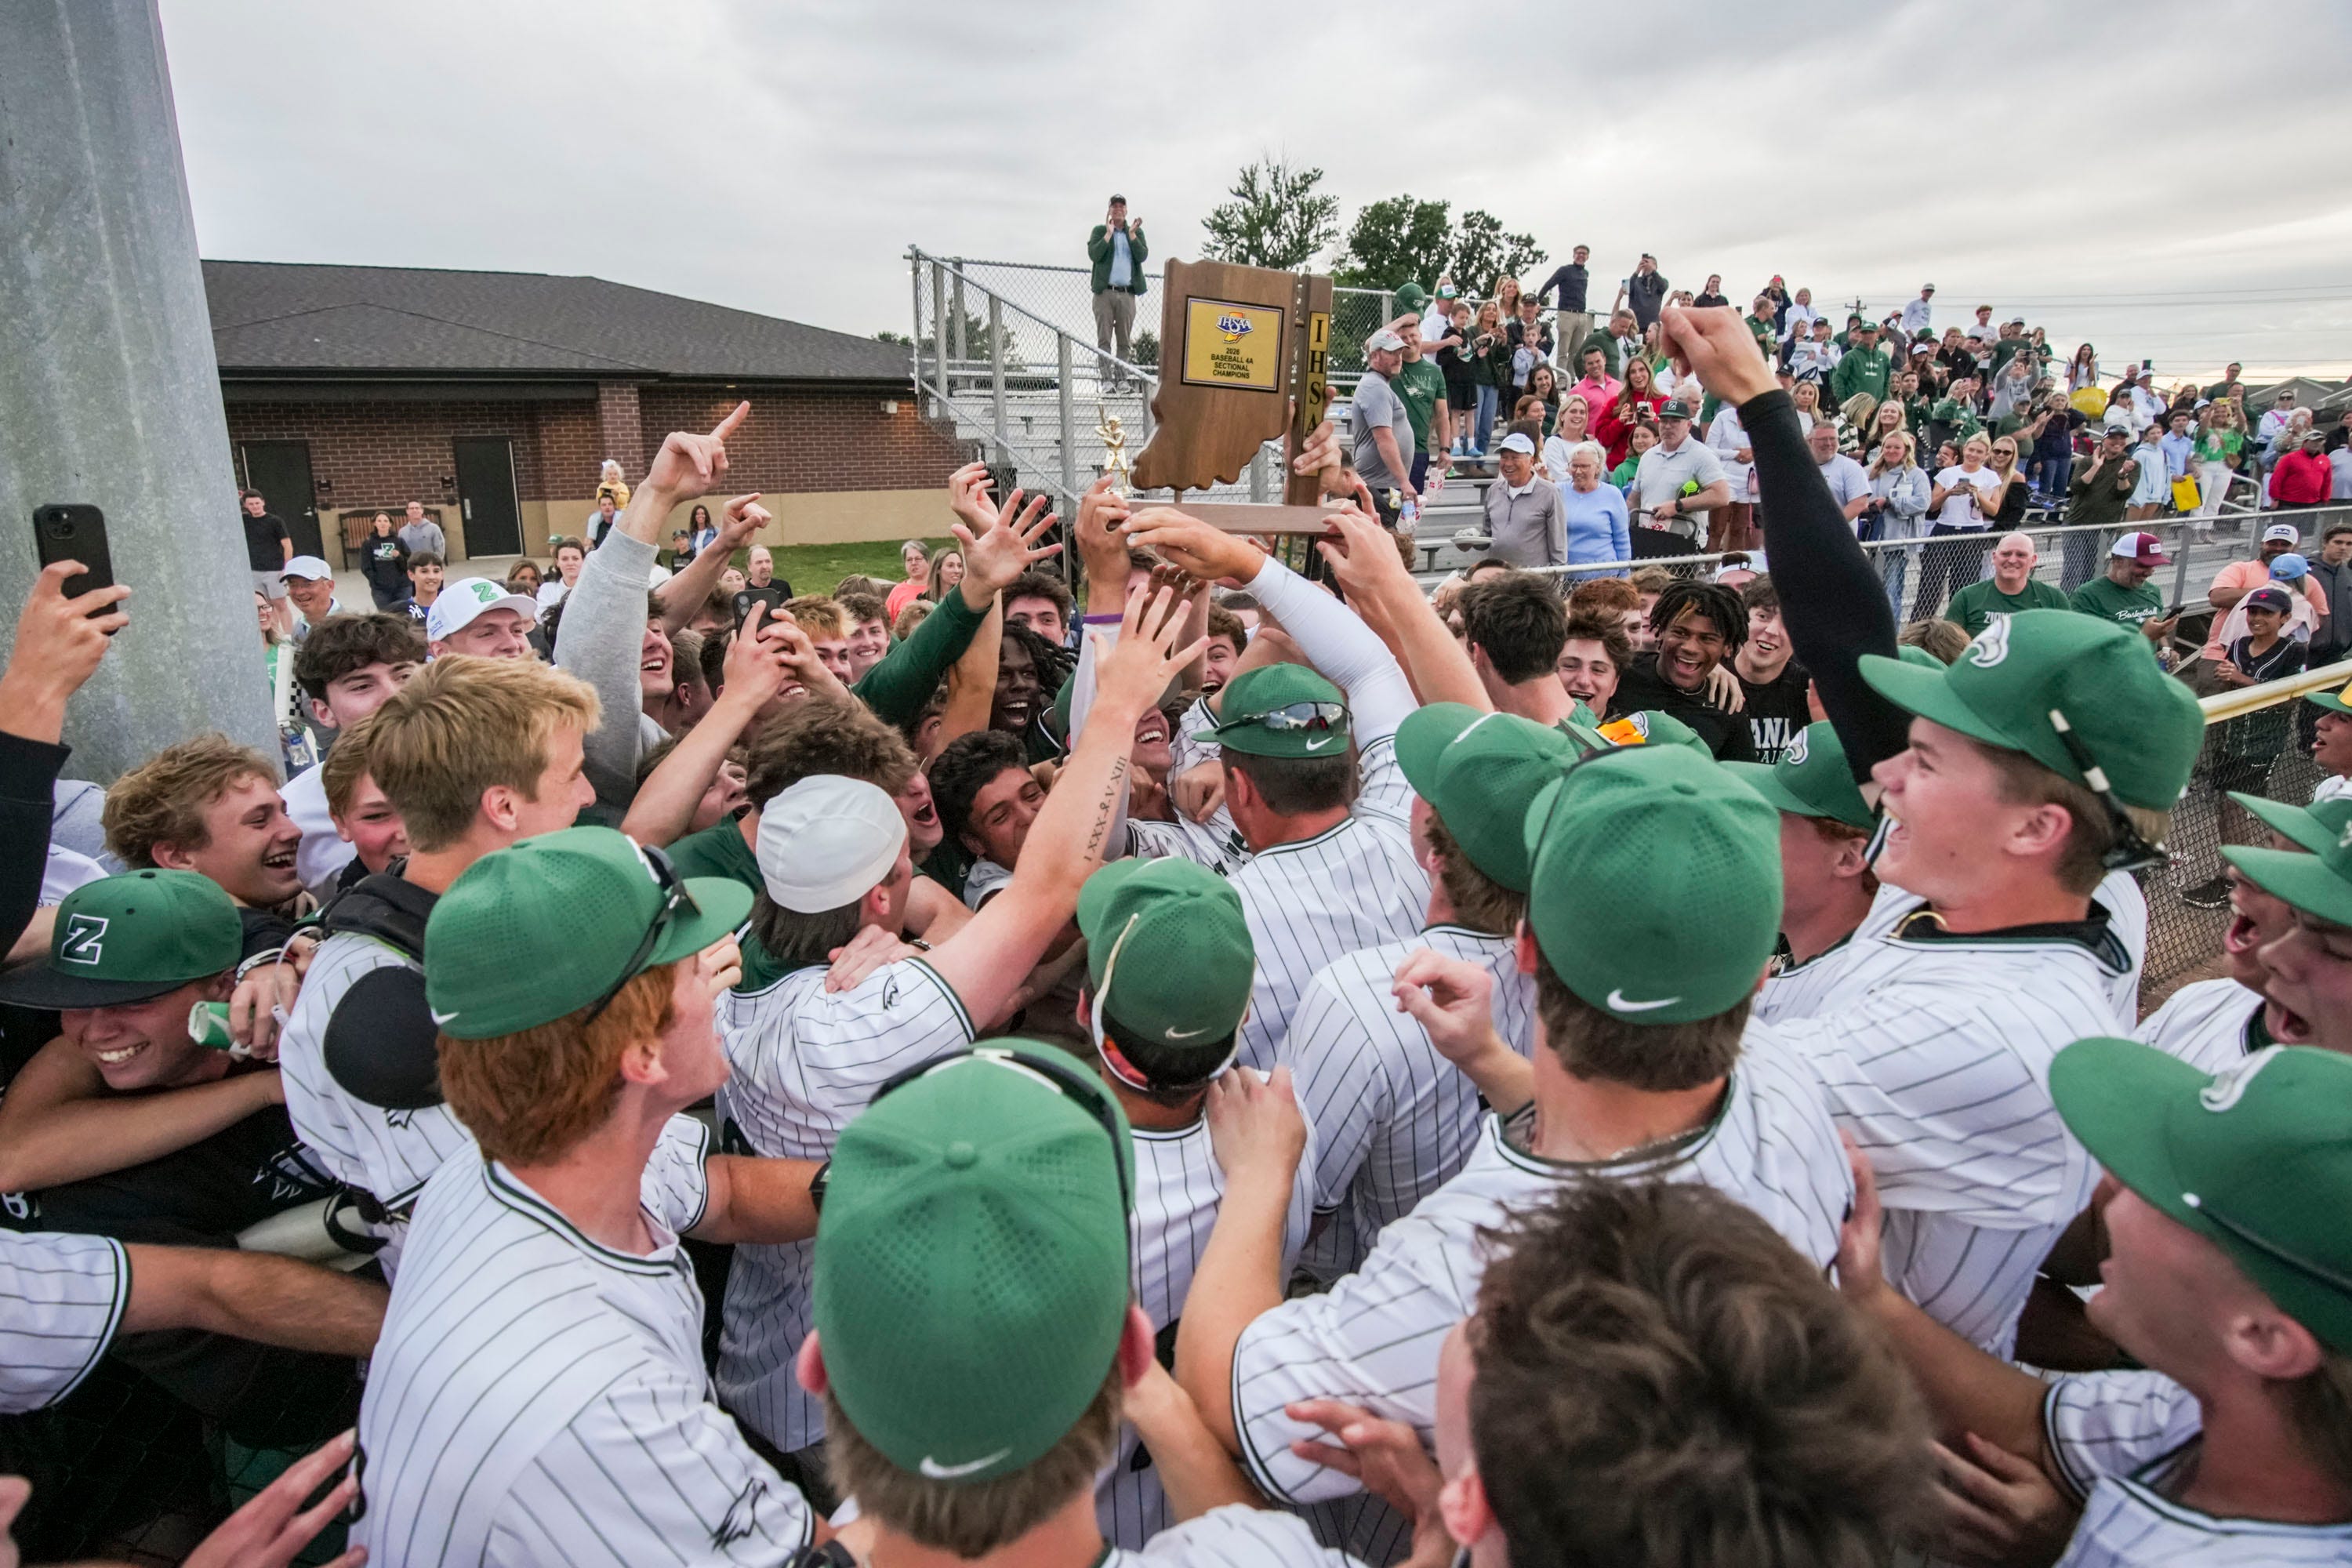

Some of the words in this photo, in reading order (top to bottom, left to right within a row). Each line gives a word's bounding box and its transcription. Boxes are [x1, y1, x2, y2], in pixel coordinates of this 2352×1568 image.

[1225, 347, 1240, 356] 2026
[1210, 354, 1244, 363] BASEBALL
[1214, 361, 1249, 372] SECTIONAL
[1212, 369, 1250, 379] CHAMPIONS
[470, 582, 499, 603] Z
[2116, 607, 2158, 622] Basketball
[60, 913, 109, 965] Z
